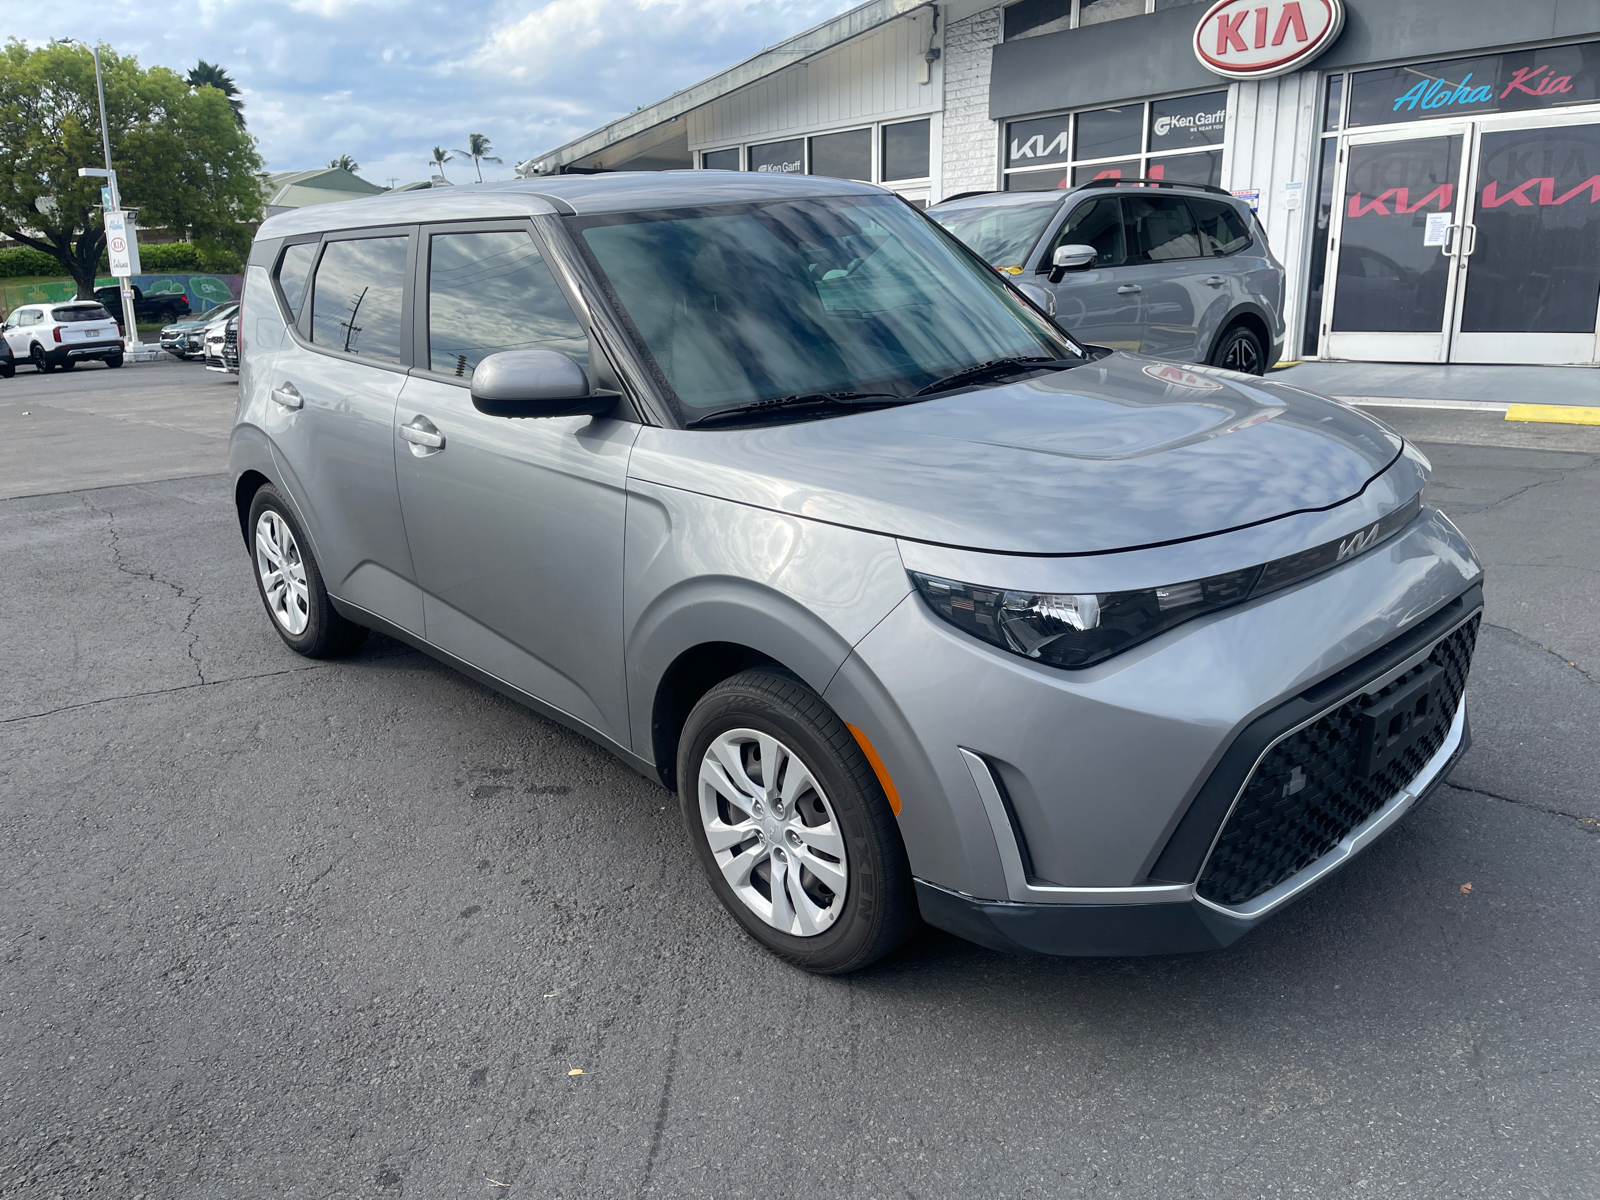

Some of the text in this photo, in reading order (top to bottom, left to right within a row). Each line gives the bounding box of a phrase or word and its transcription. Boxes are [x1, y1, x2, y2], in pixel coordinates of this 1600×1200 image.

[1216, 1, 1308, 55] KIA
[1393, 65, 1573, 111] Aloha Kia
[1171, 109, 1226, 128] Ken Garff
[1010, 131, 1068, 160] KIA
[767, 160, 801, 172] Ken Garff
[1347, 183, 1453, 218] KIA
[113, 241, 124, 250] KIA
[1336, 523, 1379, 561] KIA
[832, 780, 873, 921] NEXEN
